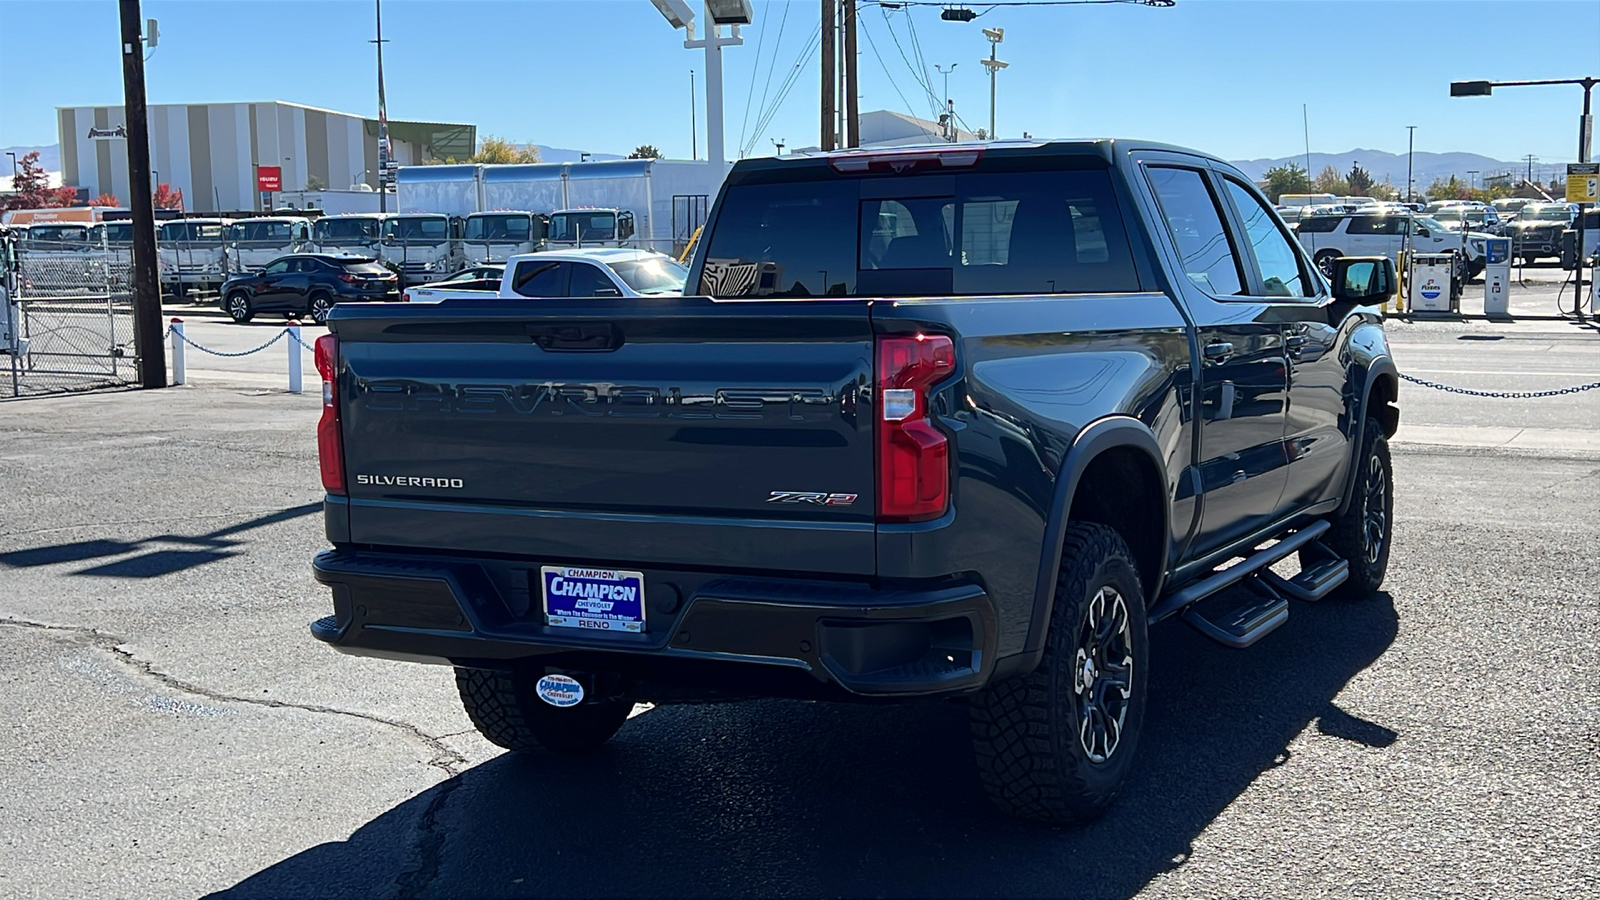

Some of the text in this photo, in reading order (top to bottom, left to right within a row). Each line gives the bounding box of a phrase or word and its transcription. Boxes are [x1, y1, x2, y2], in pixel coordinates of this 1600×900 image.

[357, 474, 464, 489] SILVERADO
[766, 490, 858, 506] ZR2
[567, 569, 615, 579] CHAMPION
[550, 577, 637, 602] CHAMPION
[577, 600, 612, 609] CHEVROLET
[579, 620, 610, 629] RENO
